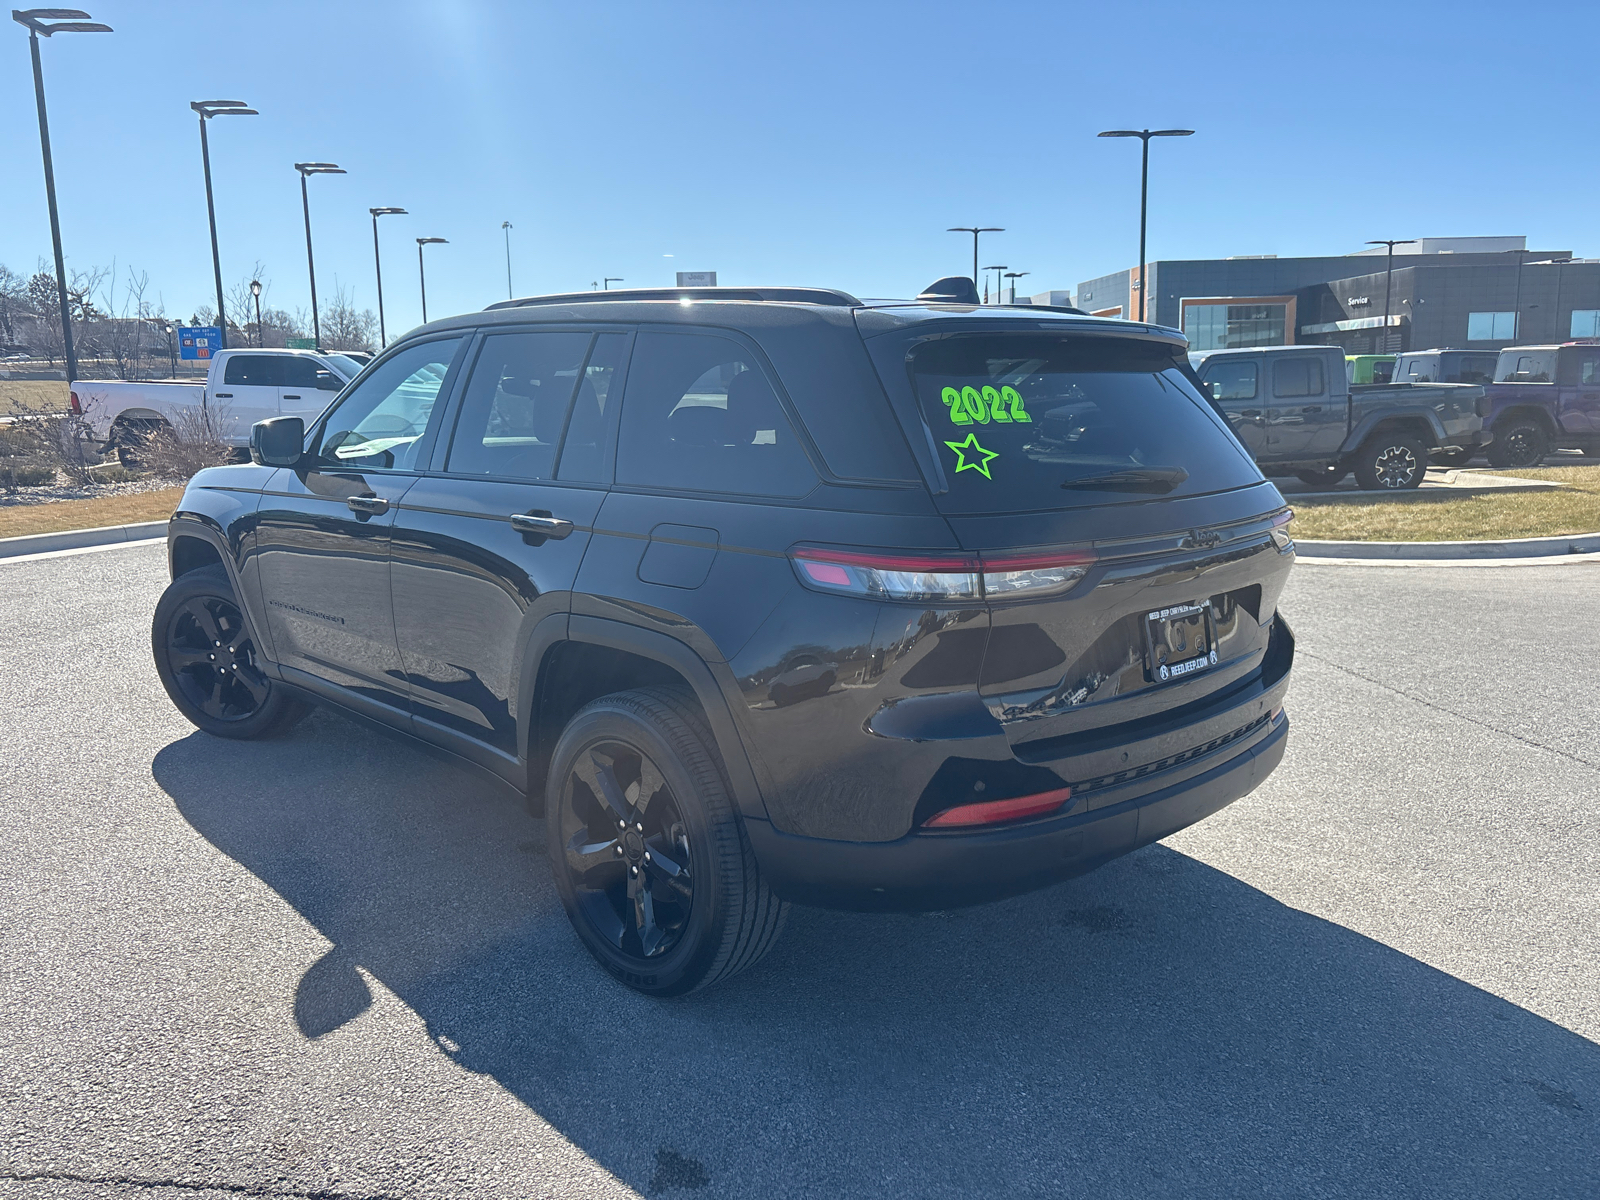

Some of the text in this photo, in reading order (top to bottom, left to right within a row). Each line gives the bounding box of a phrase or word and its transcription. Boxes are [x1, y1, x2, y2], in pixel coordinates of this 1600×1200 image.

[1347, 296, 1370, 306] Service
[941, 385, 1032, 426] 2022
[1160, 609, 1170, 618] JEEP
[1169, 605, 1189, 615] CHRYSLER
[1170, 656, 1208, 676] REEDJEEP.COM
